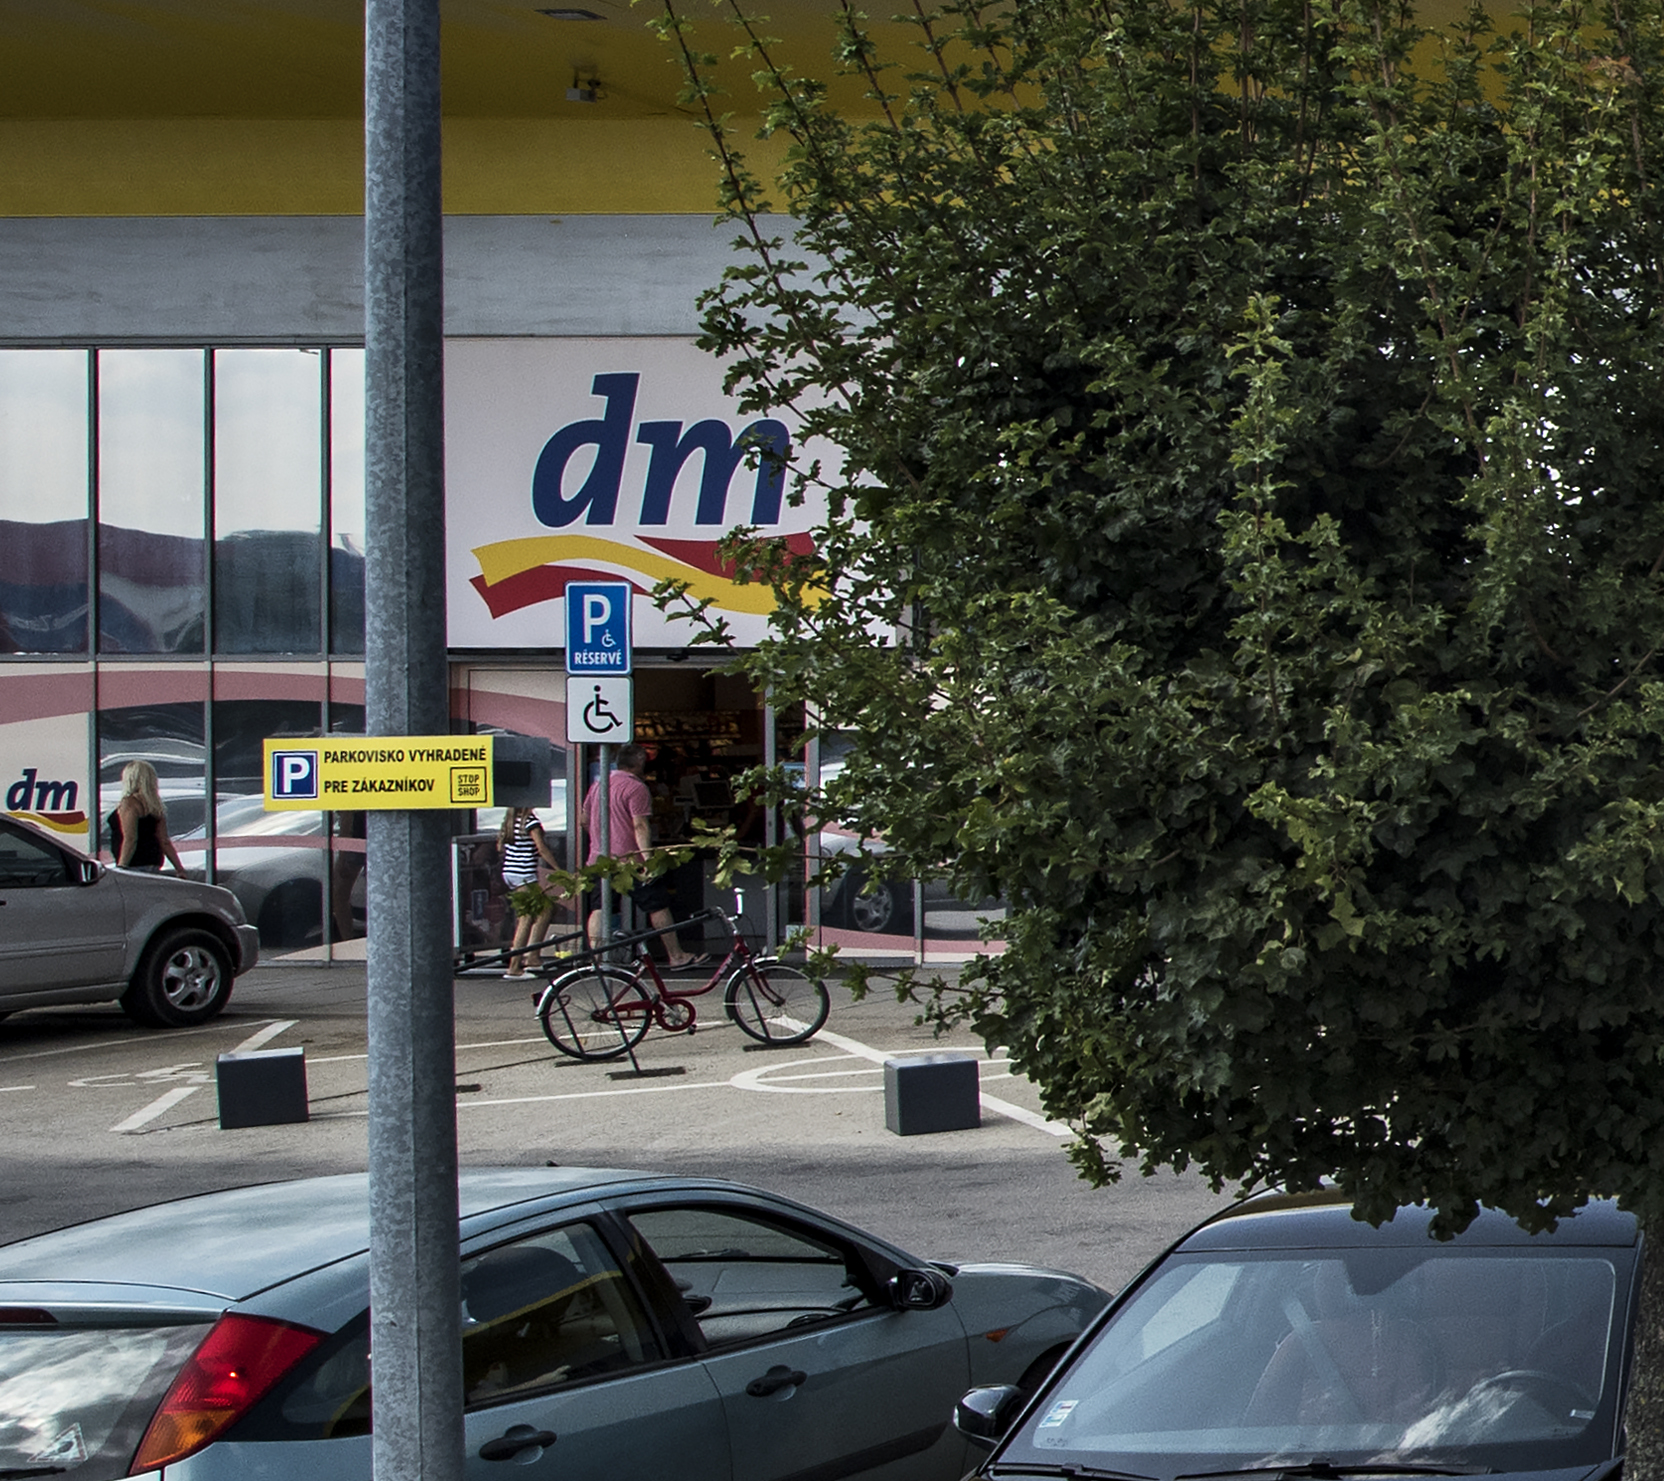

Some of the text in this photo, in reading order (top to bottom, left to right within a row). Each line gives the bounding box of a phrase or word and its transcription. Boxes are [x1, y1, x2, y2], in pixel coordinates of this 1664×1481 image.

[531, 372, 791, 528] dm
[583, 594, 612, 644] P
[574, 649, 622, 665] RÉSERVÉ
[324, 745, 487, 764] PARKOVISKO VYHRADENÉ
[282, 757, 310, 794] P
[324, 776, 435, 793] PRE ZÁKAZNÍKOV
[458, 774, 480, 784] STOP
[6, 767, 79, 811] dm
[458, 786, 480, 796] SHOP
